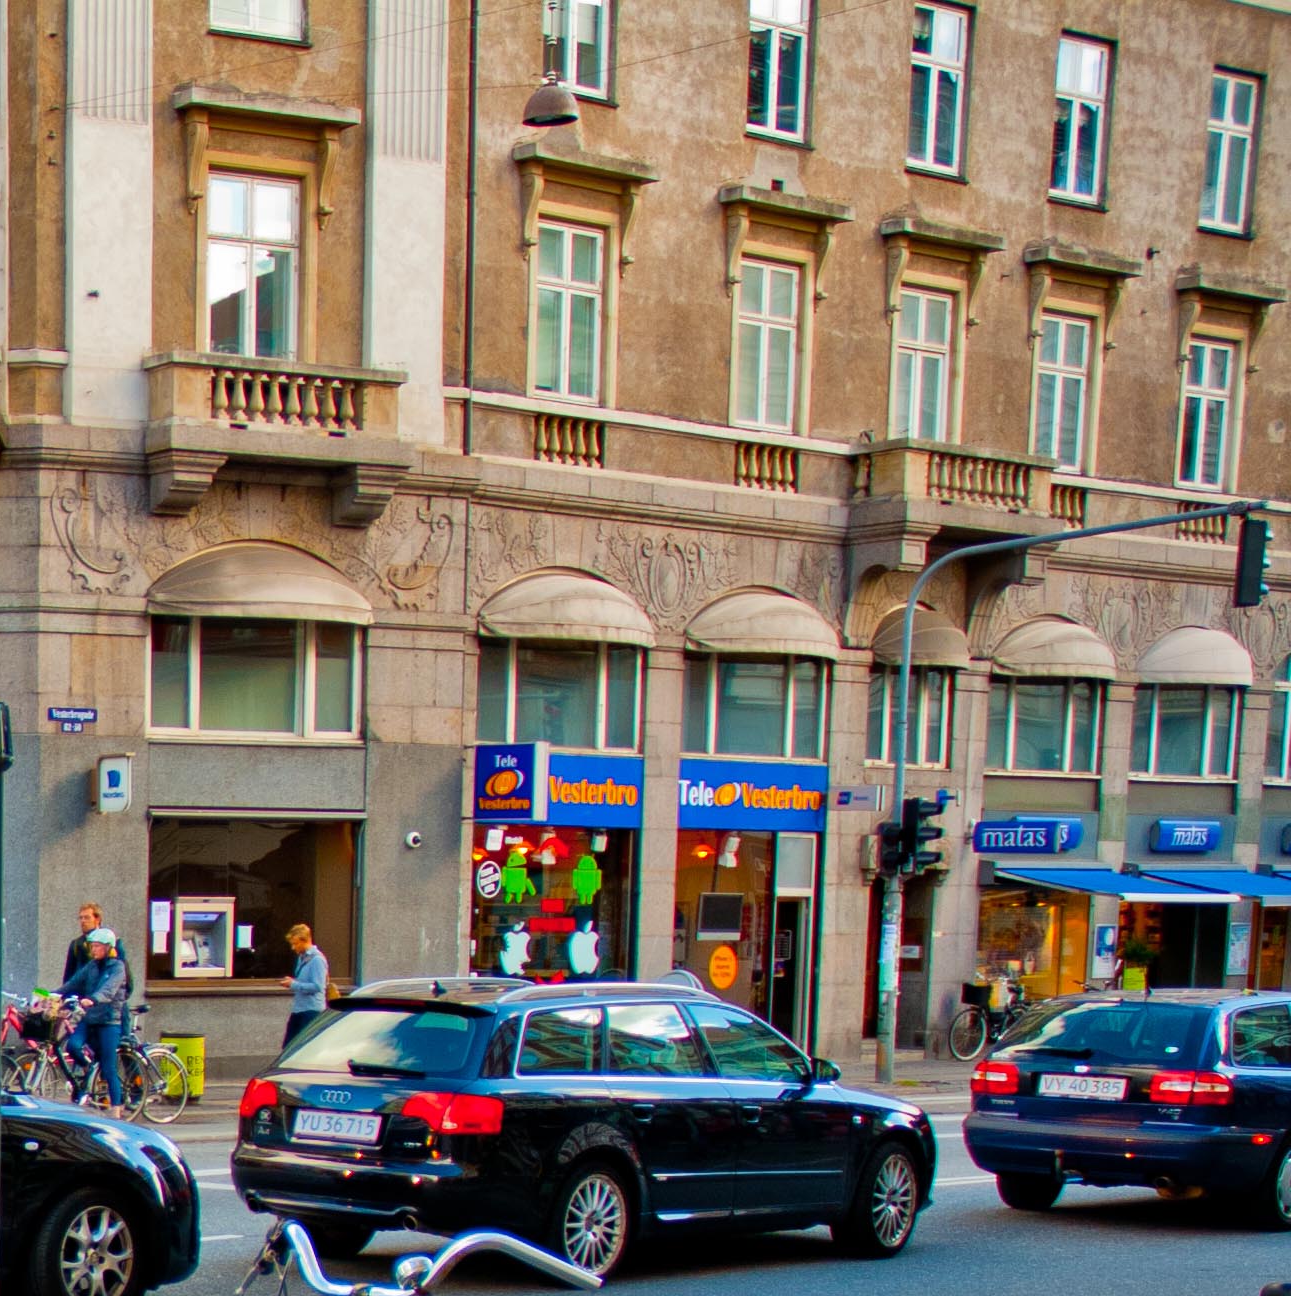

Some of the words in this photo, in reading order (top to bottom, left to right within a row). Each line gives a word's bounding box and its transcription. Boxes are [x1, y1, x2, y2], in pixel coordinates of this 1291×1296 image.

[494, 754, 518, 768] Tele
[548, 775, 638, 806] Vesterbro
[678, 780, 714, 807] Tele
[741, 783, 822, 811] Vesterbro
[478, 797, 530, 810] Vesterbro
[981, 824, 1046, 848] matas
[1171, 826, 1209, 846] matas
[1044, 1077, 1065, 1091] VY
[1068, 1079, 1088, 1093] 40
[1090, 1080, 1121, 1095] 385
[300, 1113, 320, 1131] YU
[322, 1115, 343, 1132] 36
[345, 1117, 377, 1136] 715
